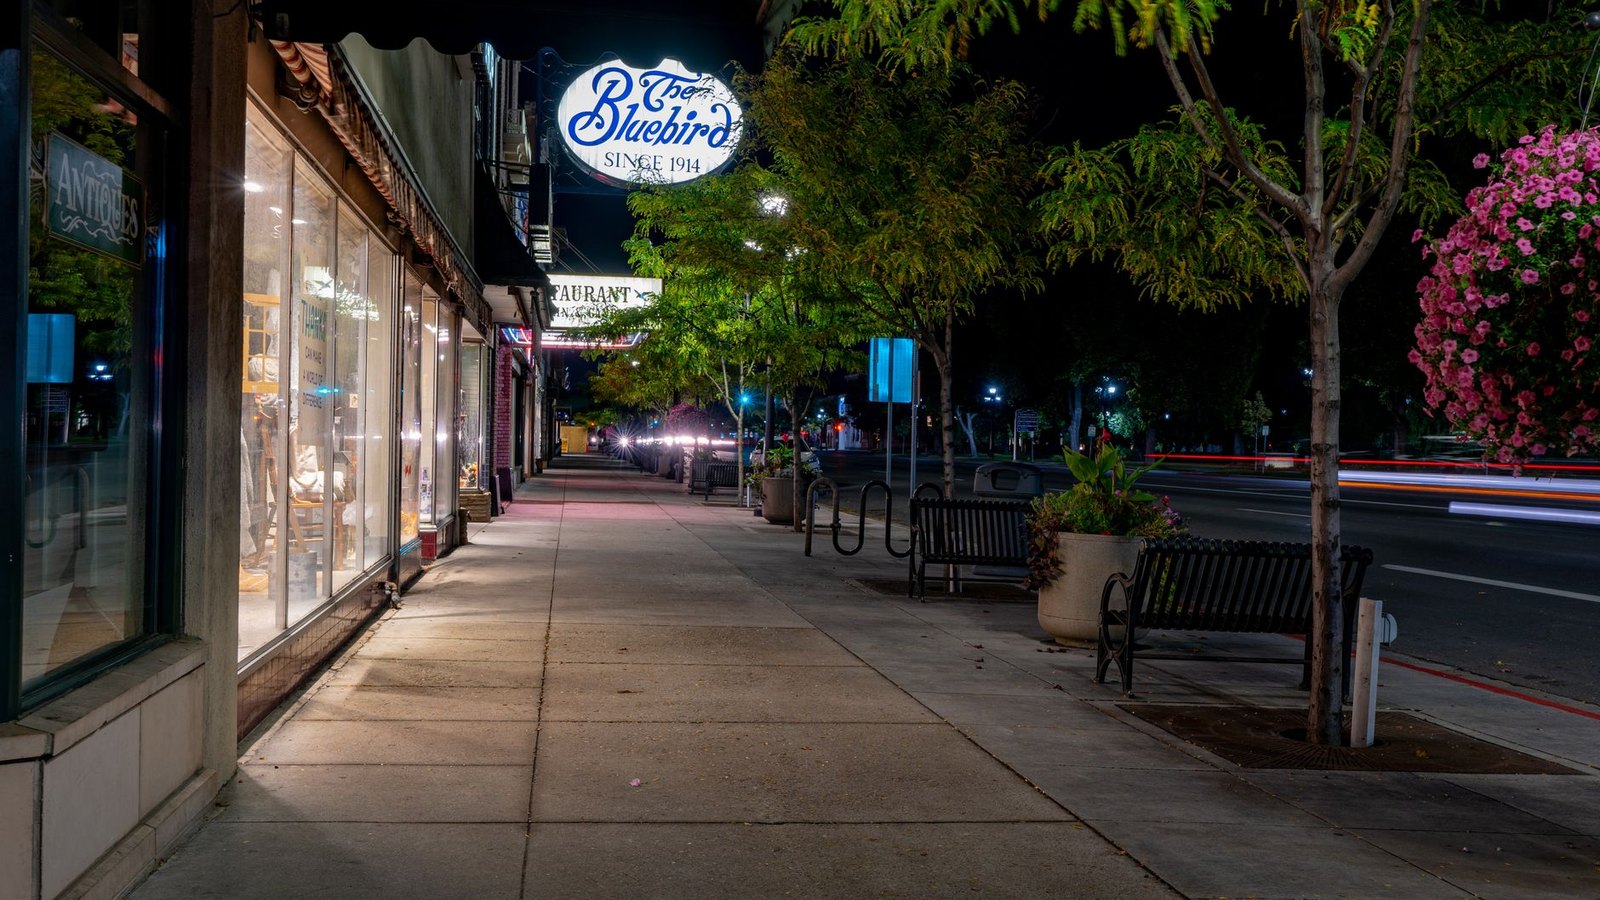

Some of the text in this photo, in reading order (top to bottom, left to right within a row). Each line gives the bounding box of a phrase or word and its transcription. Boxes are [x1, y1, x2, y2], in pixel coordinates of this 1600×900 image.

[567, 66, 733, 147] Bluebird
[638, 70, 703, 113] The
[603, 151, 701, 174] SINCE 1914
[54, 152, 139, 241] ANTIQUES
